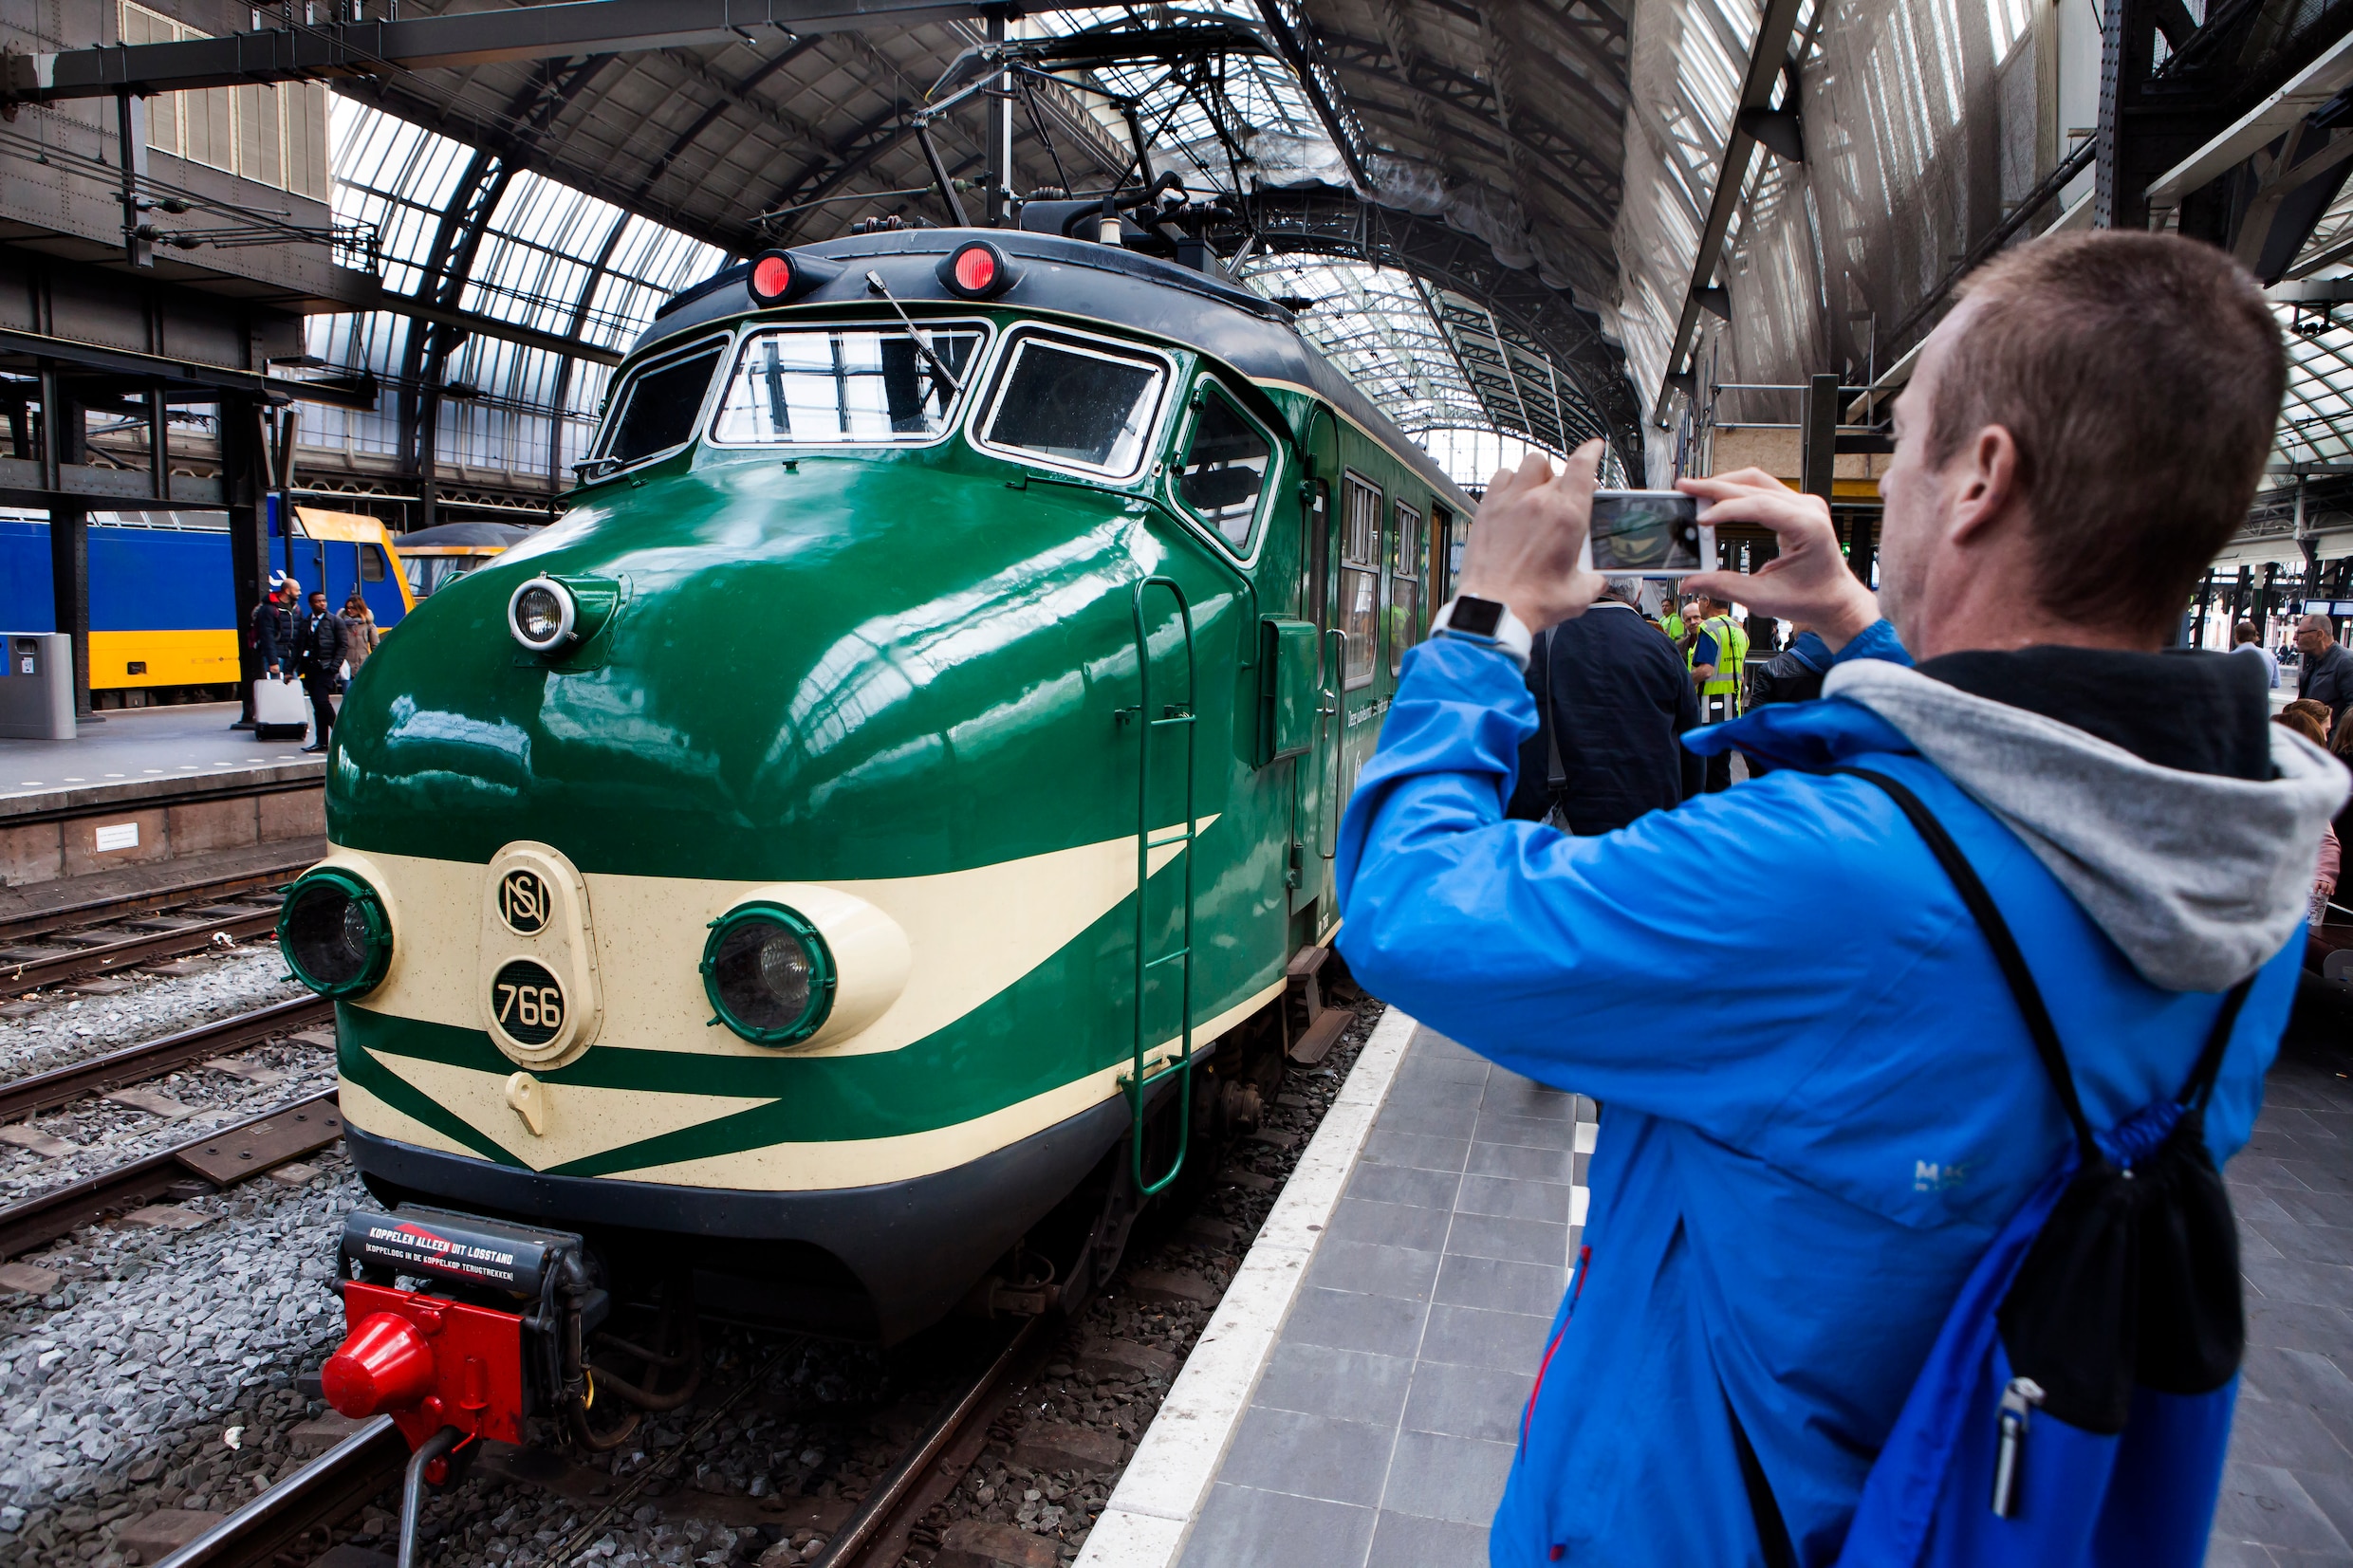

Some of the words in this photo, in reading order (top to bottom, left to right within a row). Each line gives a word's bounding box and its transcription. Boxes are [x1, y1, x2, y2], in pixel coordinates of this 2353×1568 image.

[498, 984, 561, 1027] 766
[369, 1227, 415, 1245] KOPPELEN
[416, 1236, 450, 1252] ALLEEN
[451, 1242, 467, 1255] UIT
[468, 1246, 513, 1264] LOSSTAND
[413, 1253, 422, 1263] DE
[423, 1255, 461, 1269] KOPPELKOP
